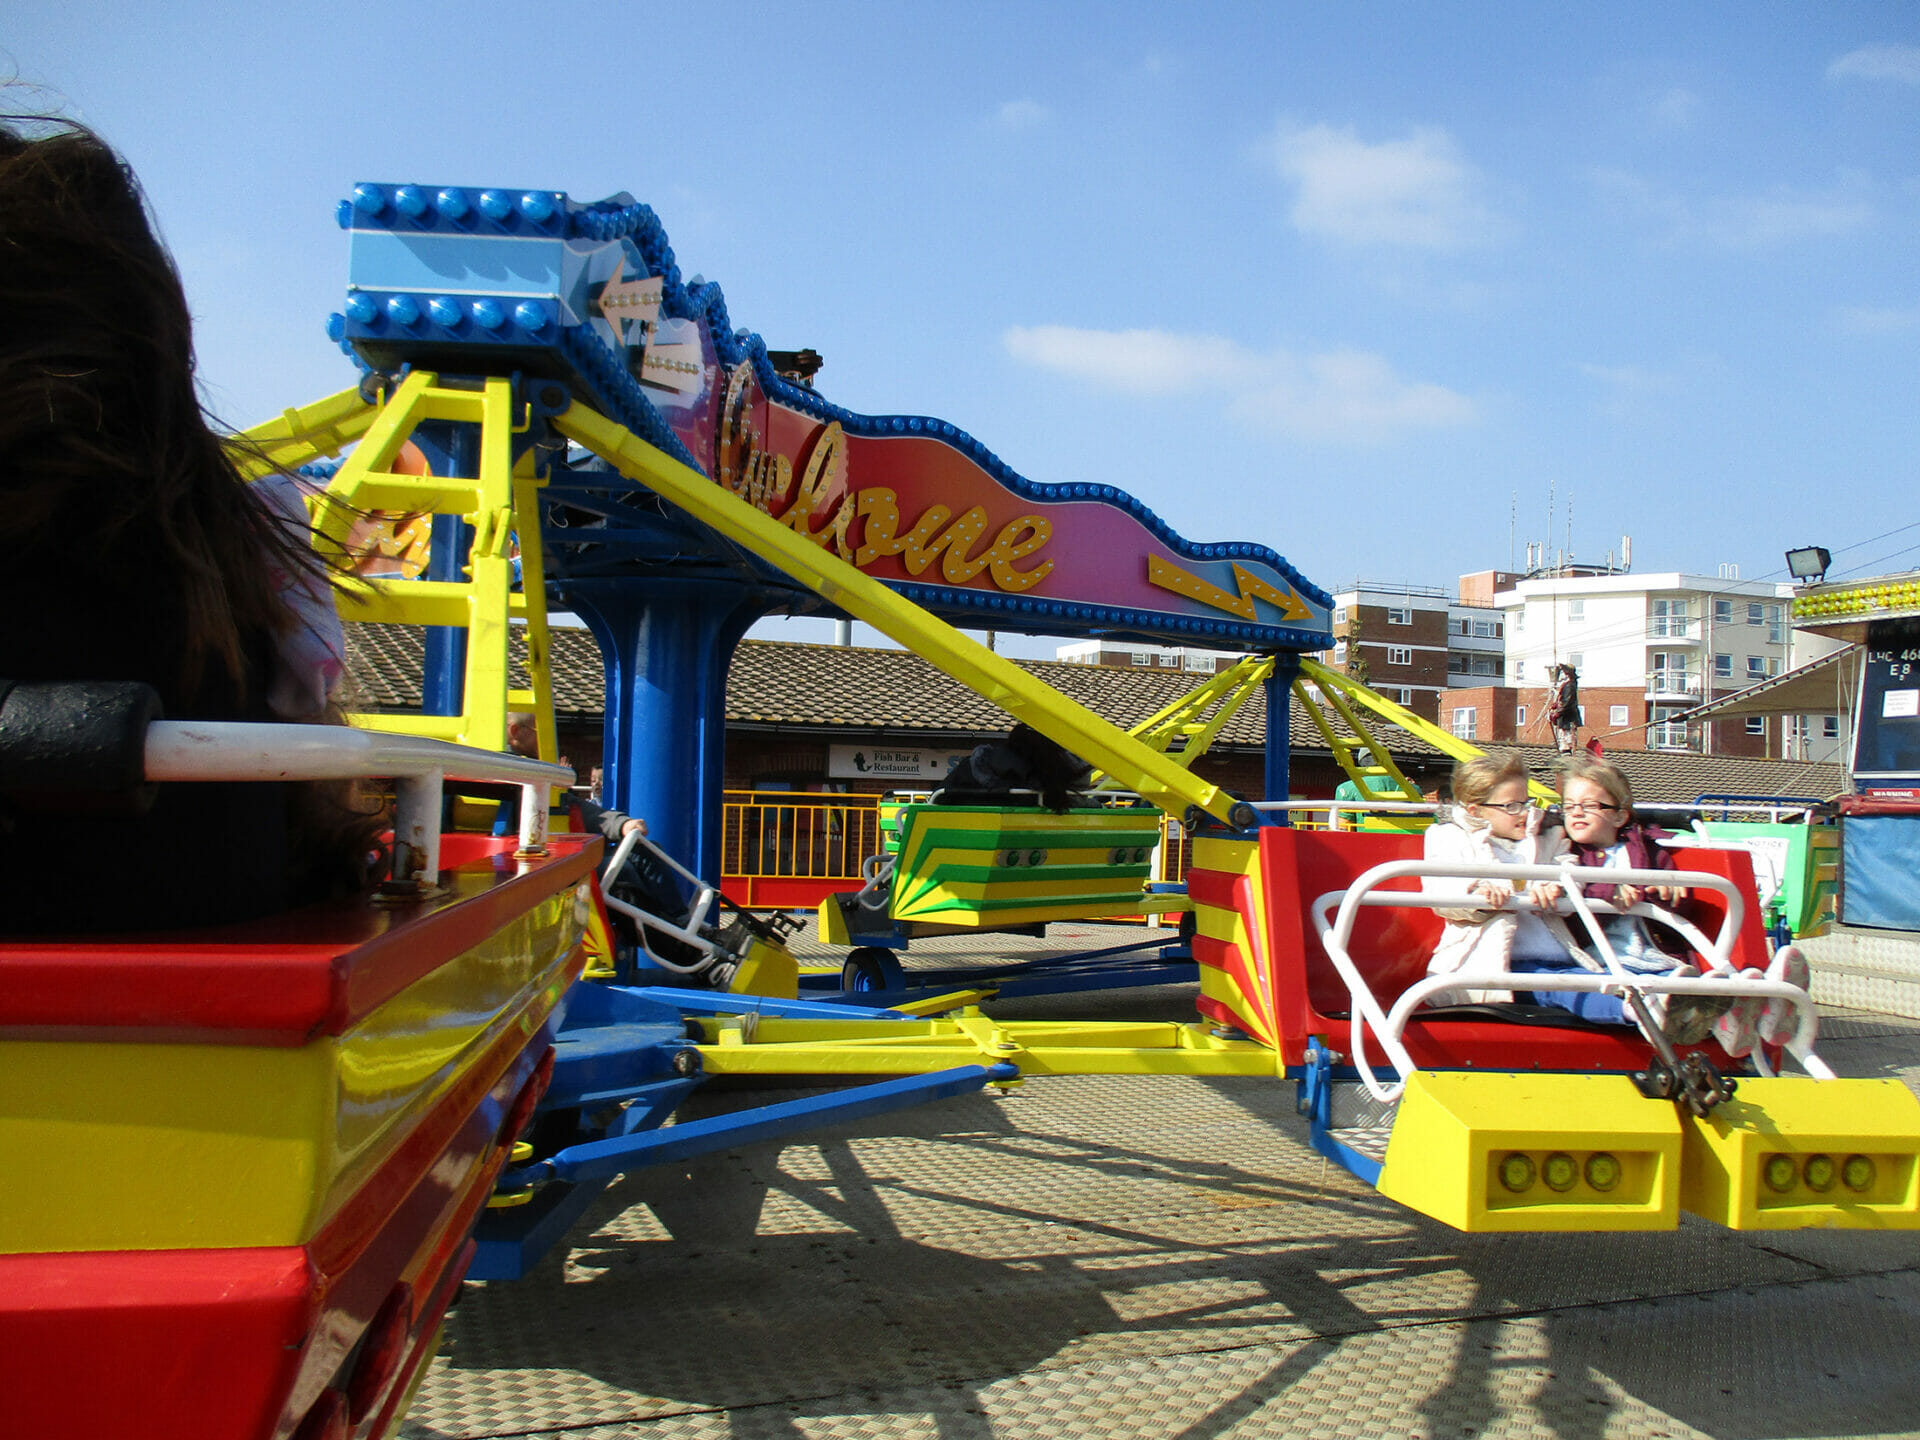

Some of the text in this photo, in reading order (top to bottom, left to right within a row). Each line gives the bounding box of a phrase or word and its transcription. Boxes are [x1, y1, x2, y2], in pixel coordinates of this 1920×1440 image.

[874, 752, 919, 762] Fish Bar &
[874, 763, 920, 773] Restaurant
[1747, 840, 1784, 848] NOTICE
